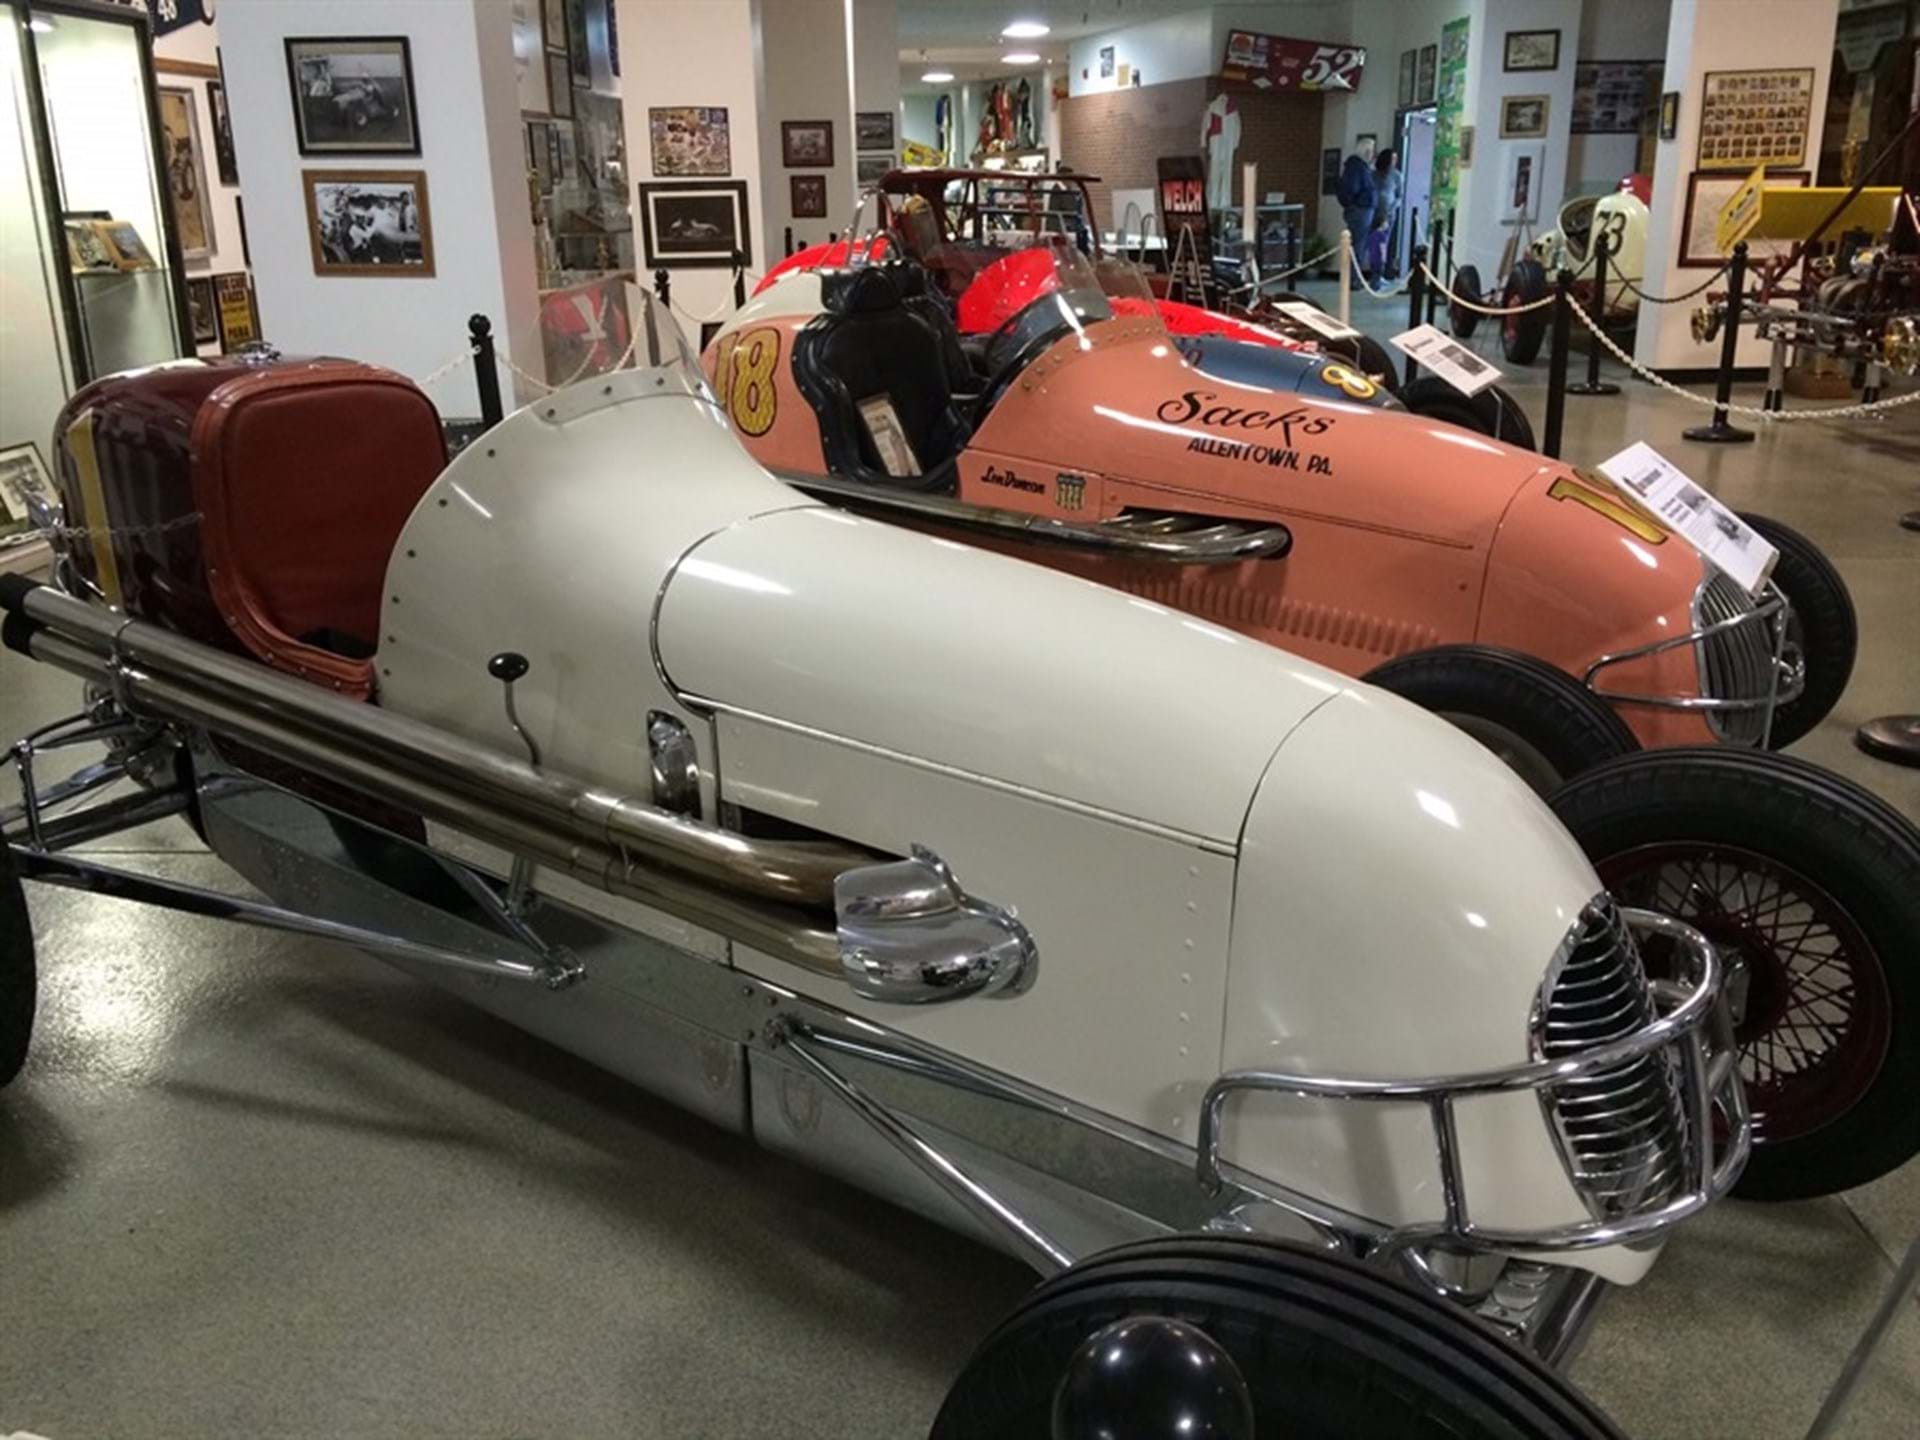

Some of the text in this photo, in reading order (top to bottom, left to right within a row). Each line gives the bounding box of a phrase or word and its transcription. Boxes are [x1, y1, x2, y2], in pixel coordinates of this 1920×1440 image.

[1302, 46, 1357, 90] 52
[1597, 211, 1627, 256] 73
[713, 326, 781, 438] 18
[1321, 364, 1376, 399] 8
[1157, 389, 1336, 448] Sacks
[1306, 455, 1333, 476] PA.
